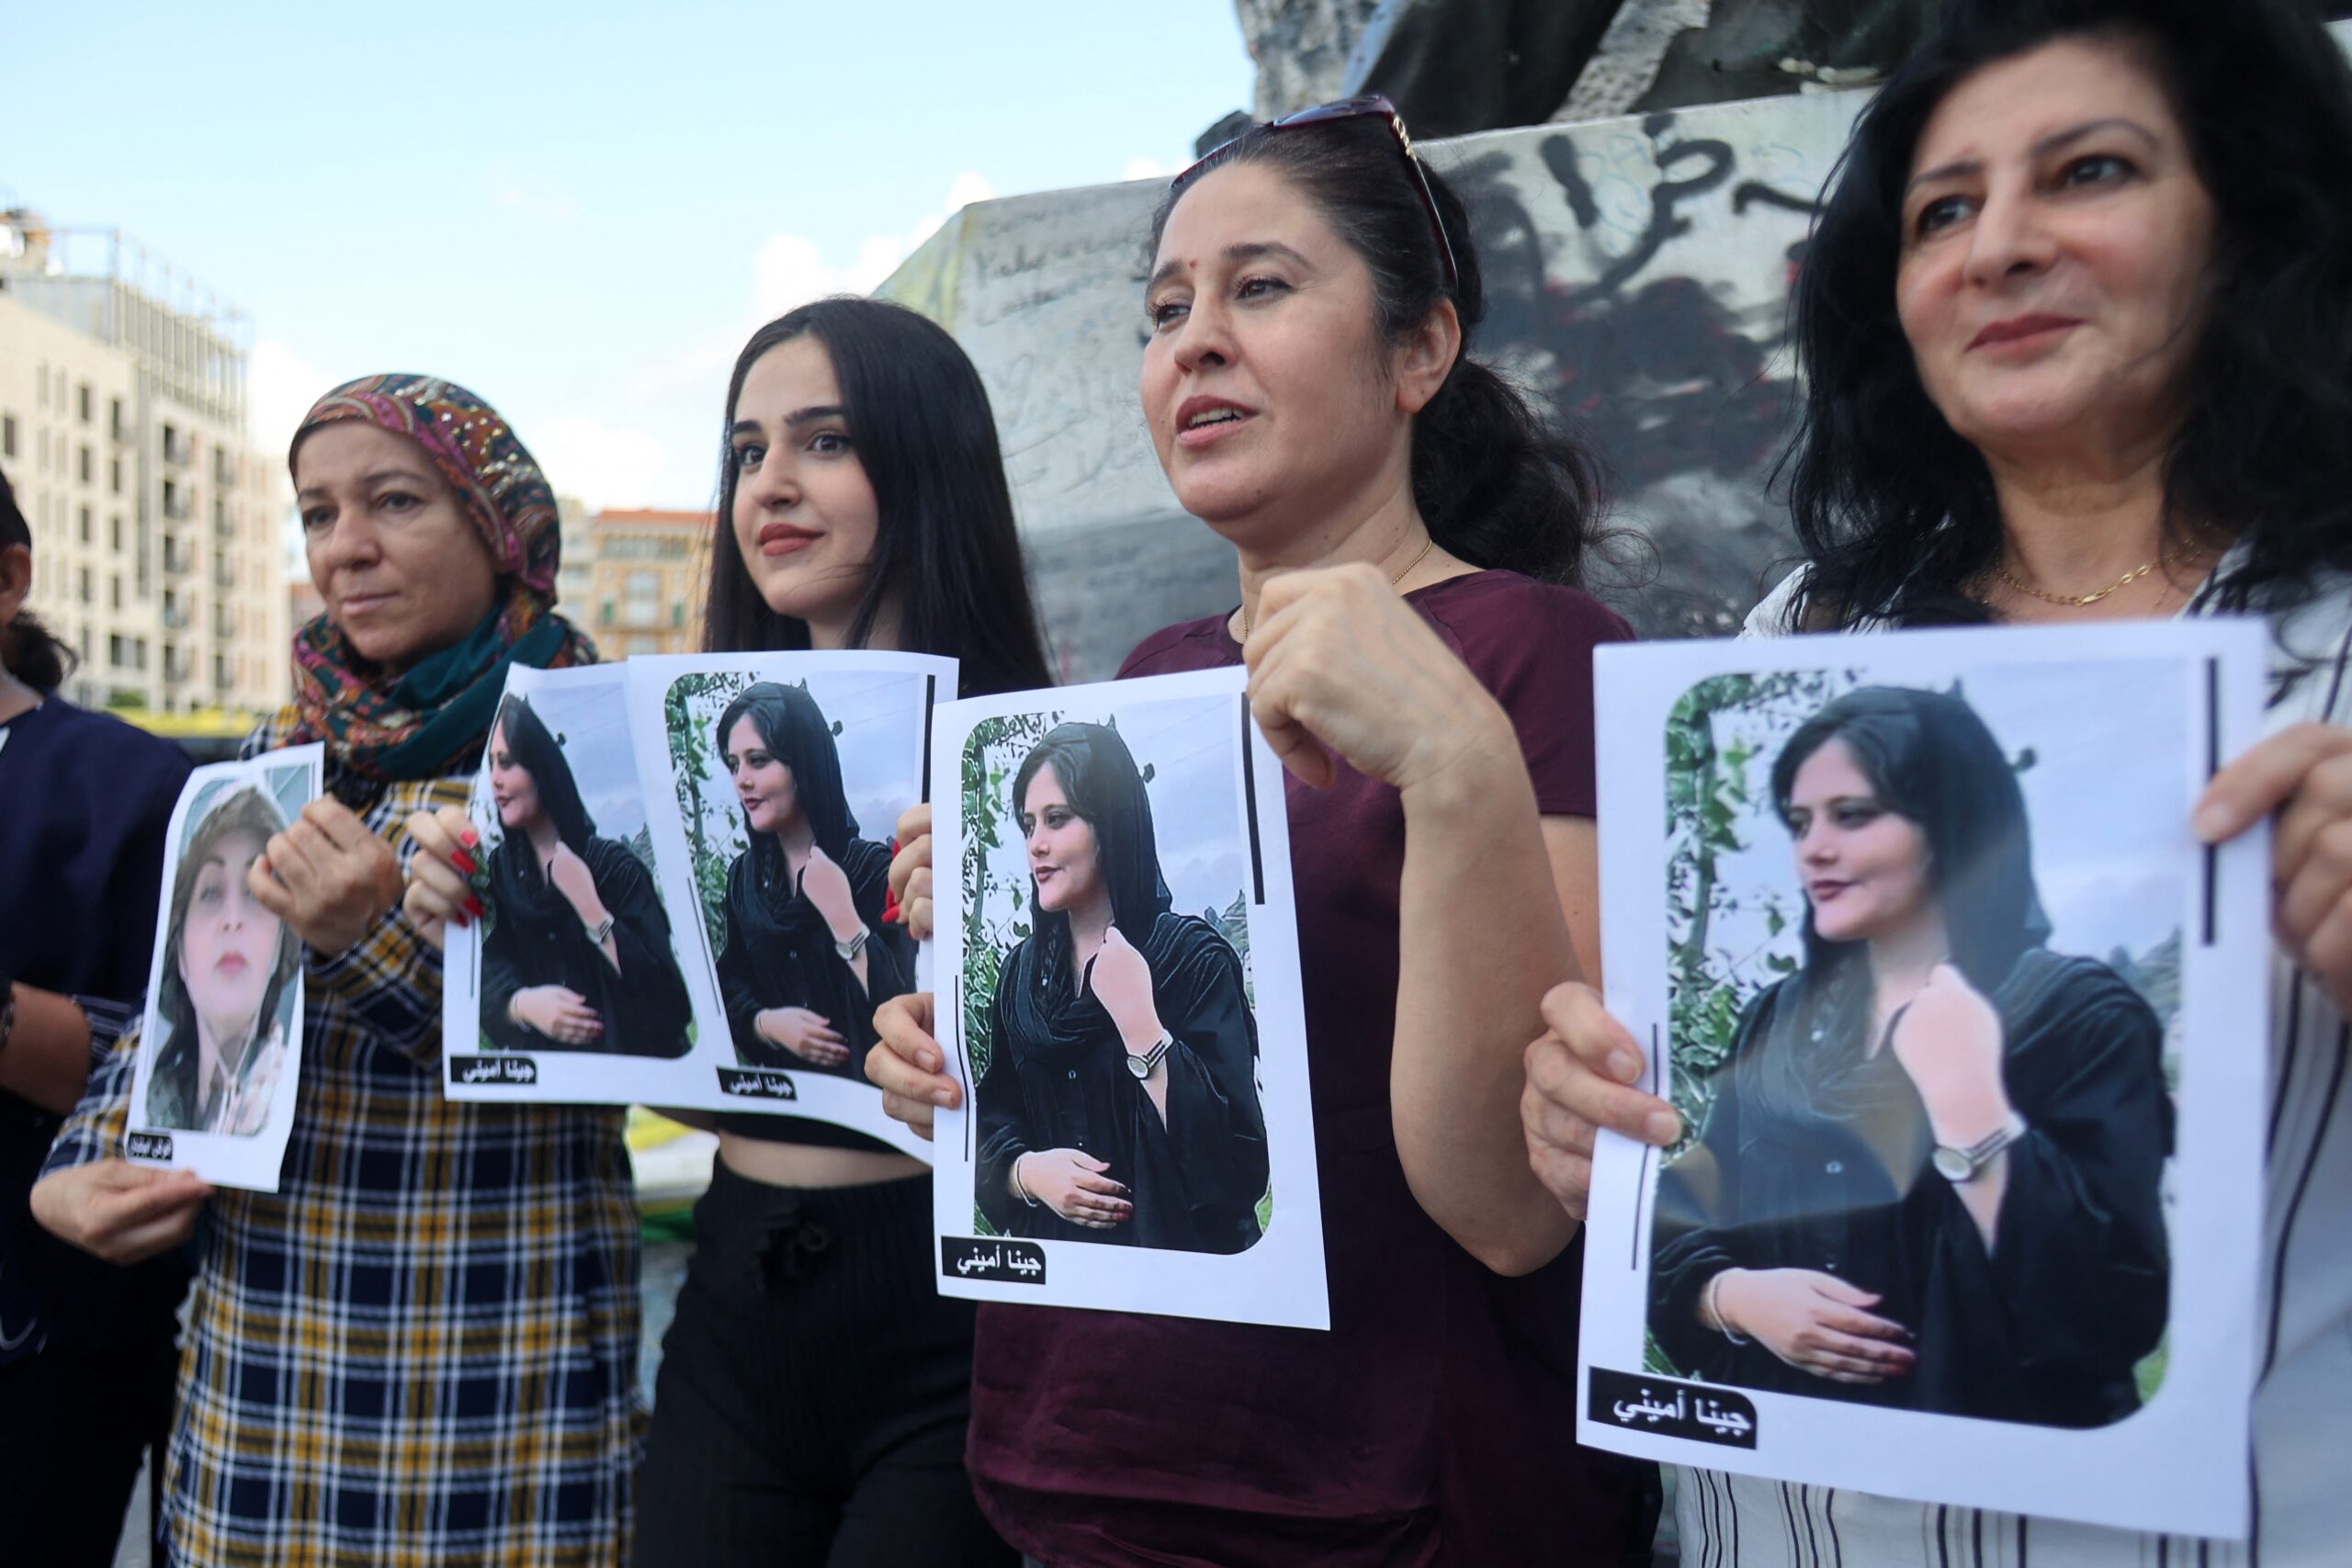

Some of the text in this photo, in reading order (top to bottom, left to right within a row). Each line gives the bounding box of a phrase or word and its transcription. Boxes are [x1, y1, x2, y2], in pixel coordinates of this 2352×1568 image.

[956, 1244, 1042, 1276] جينا أميني
[1613, 1388, 1751, 1437] جينا أميني
